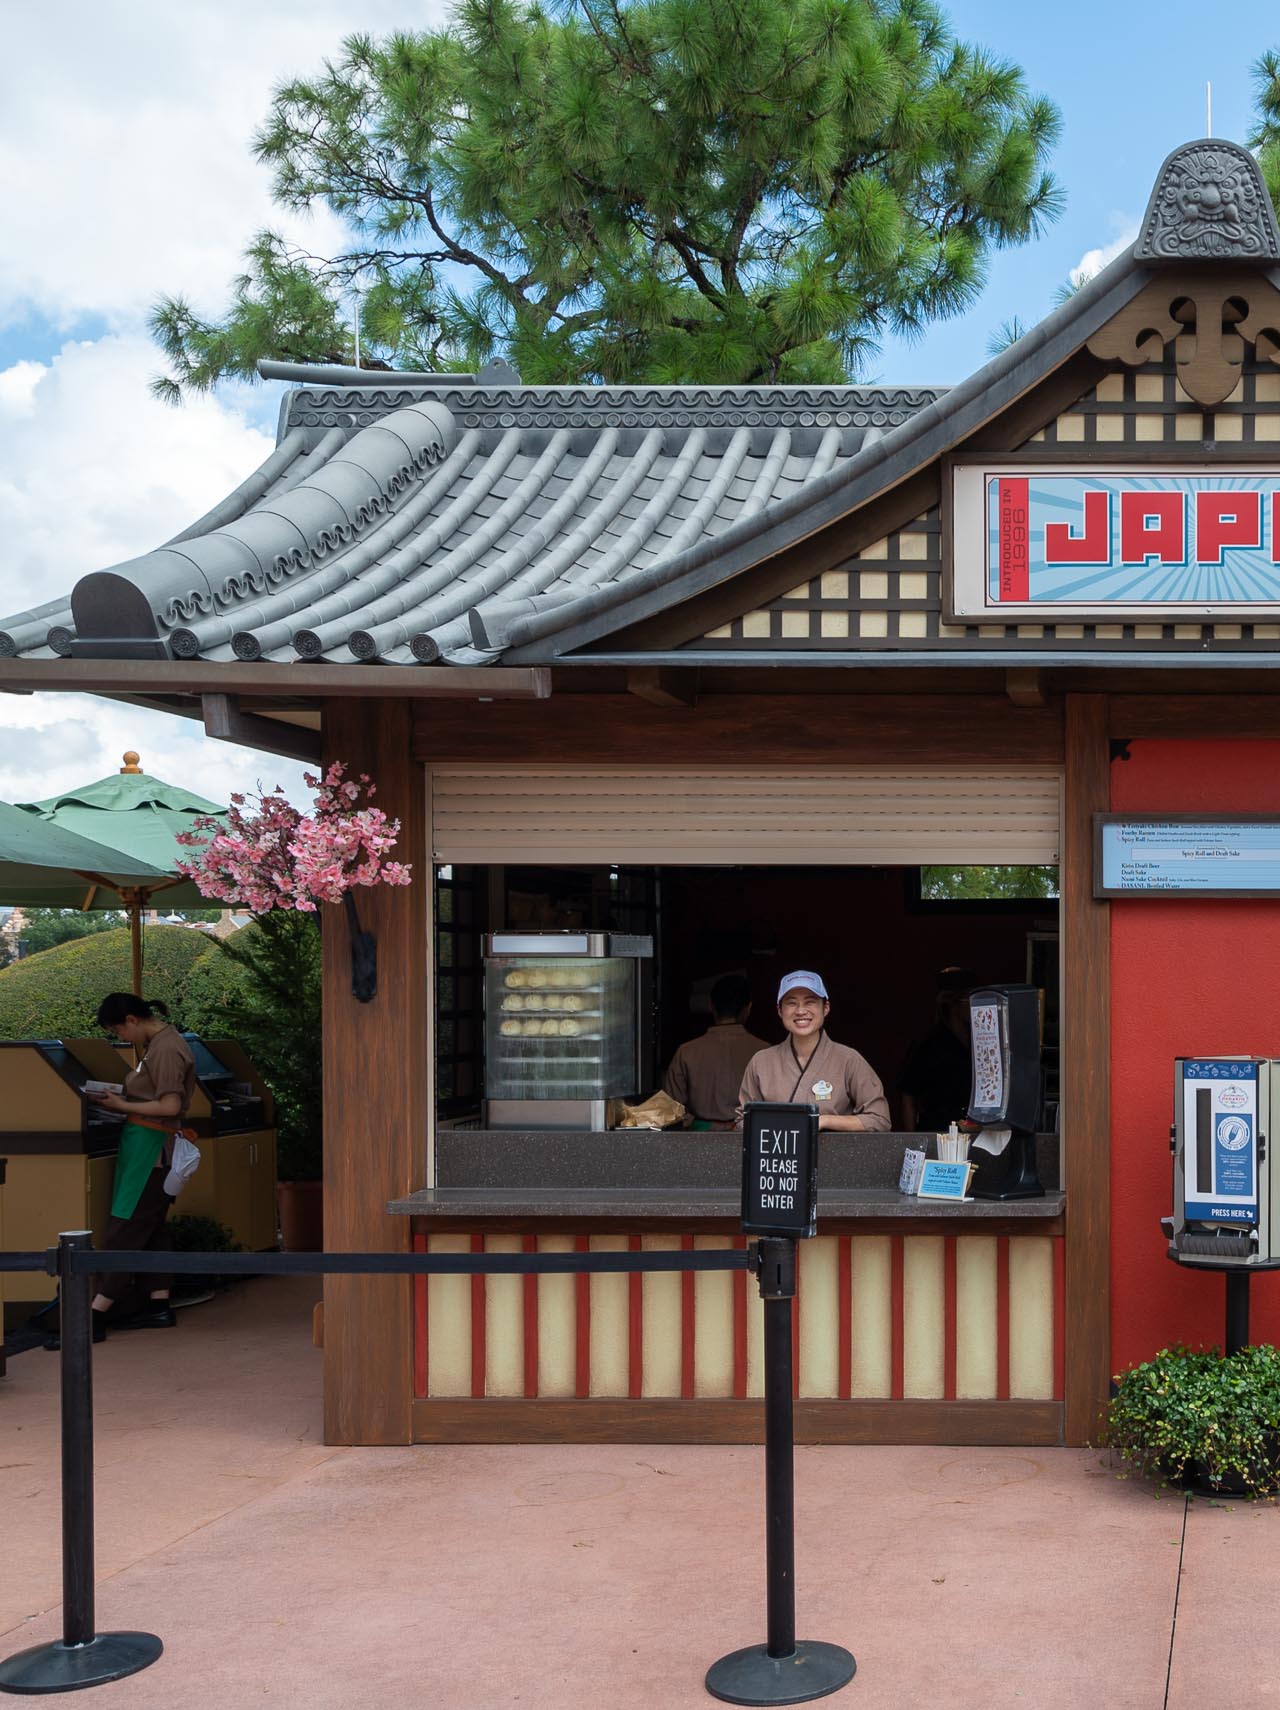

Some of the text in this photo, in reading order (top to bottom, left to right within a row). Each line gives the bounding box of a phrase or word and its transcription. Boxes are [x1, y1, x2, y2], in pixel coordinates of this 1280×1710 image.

[1002, 488, 1012, 592] INTRODUCED IN
[1012, 507, 1026, 572] 1996
[1181, 850, 1194, 858] Spicy
[759, 1128, 801, 1155] EXIT
[759, 1158, 798, 1175] PLEASE
[759, 1175, 799, 1192] DO NOT
[760, 1193, 794, 1210] ENTER
[1211, 1208, 1247, 1218] PRESS HERE
